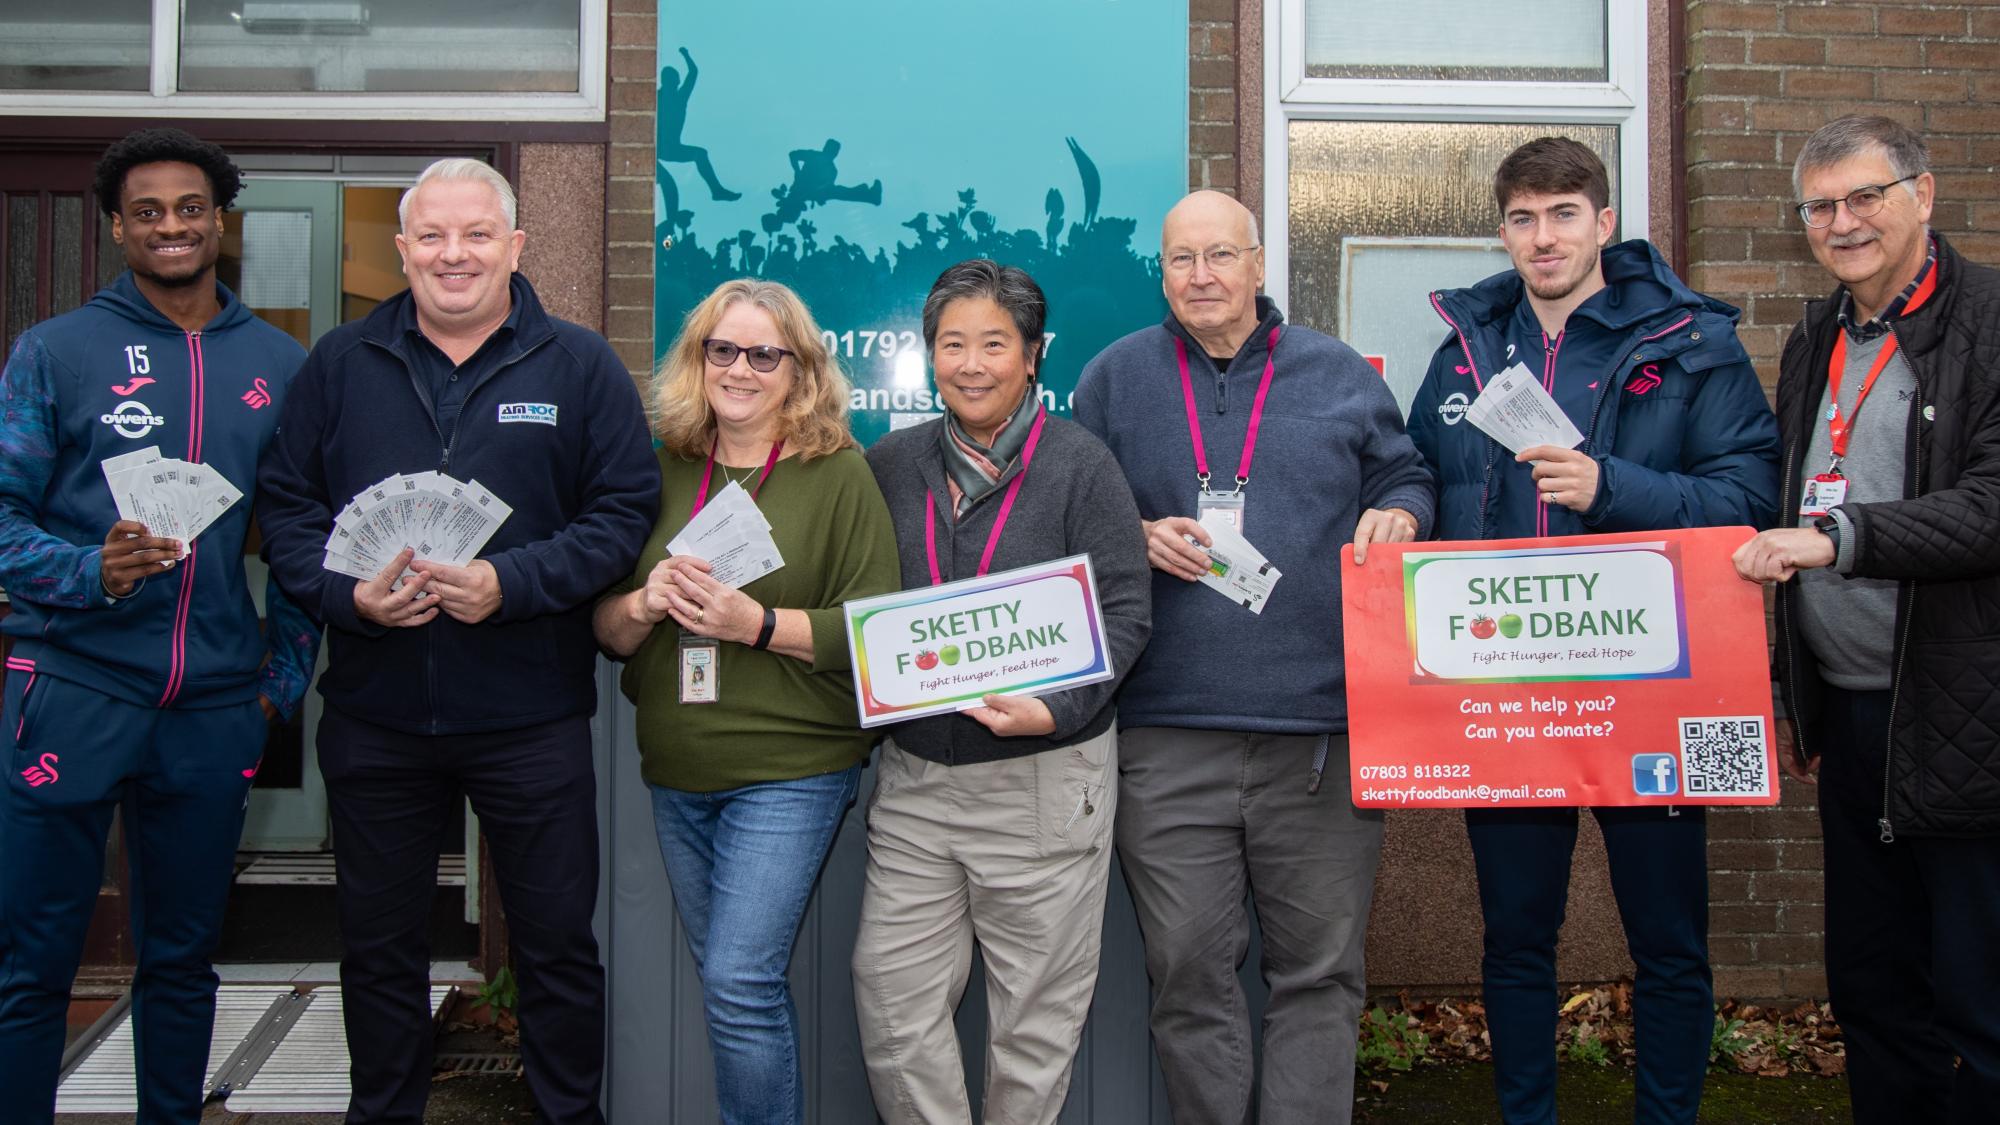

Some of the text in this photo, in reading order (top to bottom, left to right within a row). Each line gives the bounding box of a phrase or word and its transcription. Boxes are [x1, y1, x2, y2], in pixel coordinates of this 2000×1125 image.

[124, 345, 150, 374] 15
[501, 405, 556, 416] AMROC
[1438, 404, 1469, 413] owen
[101, 414, 164, 426] owens
[1468, 573, 1600, 605] SKETTY
[909, 600, 1022, 644] SKETTY
[1472, 648, 1637, 664] Fight Hunger, Feed Hope
[920, 656, 1060, 691] Fight Hunger, Feed Hope
[1460, 696, 1616, 716] Can we help you?
[1465, 721, 1614, 742] Can you donate?
[1360, 765, 1471, 779] 07803 818322
[1361, 785, 1566, 803] skettyfoodbank@gmail.com
